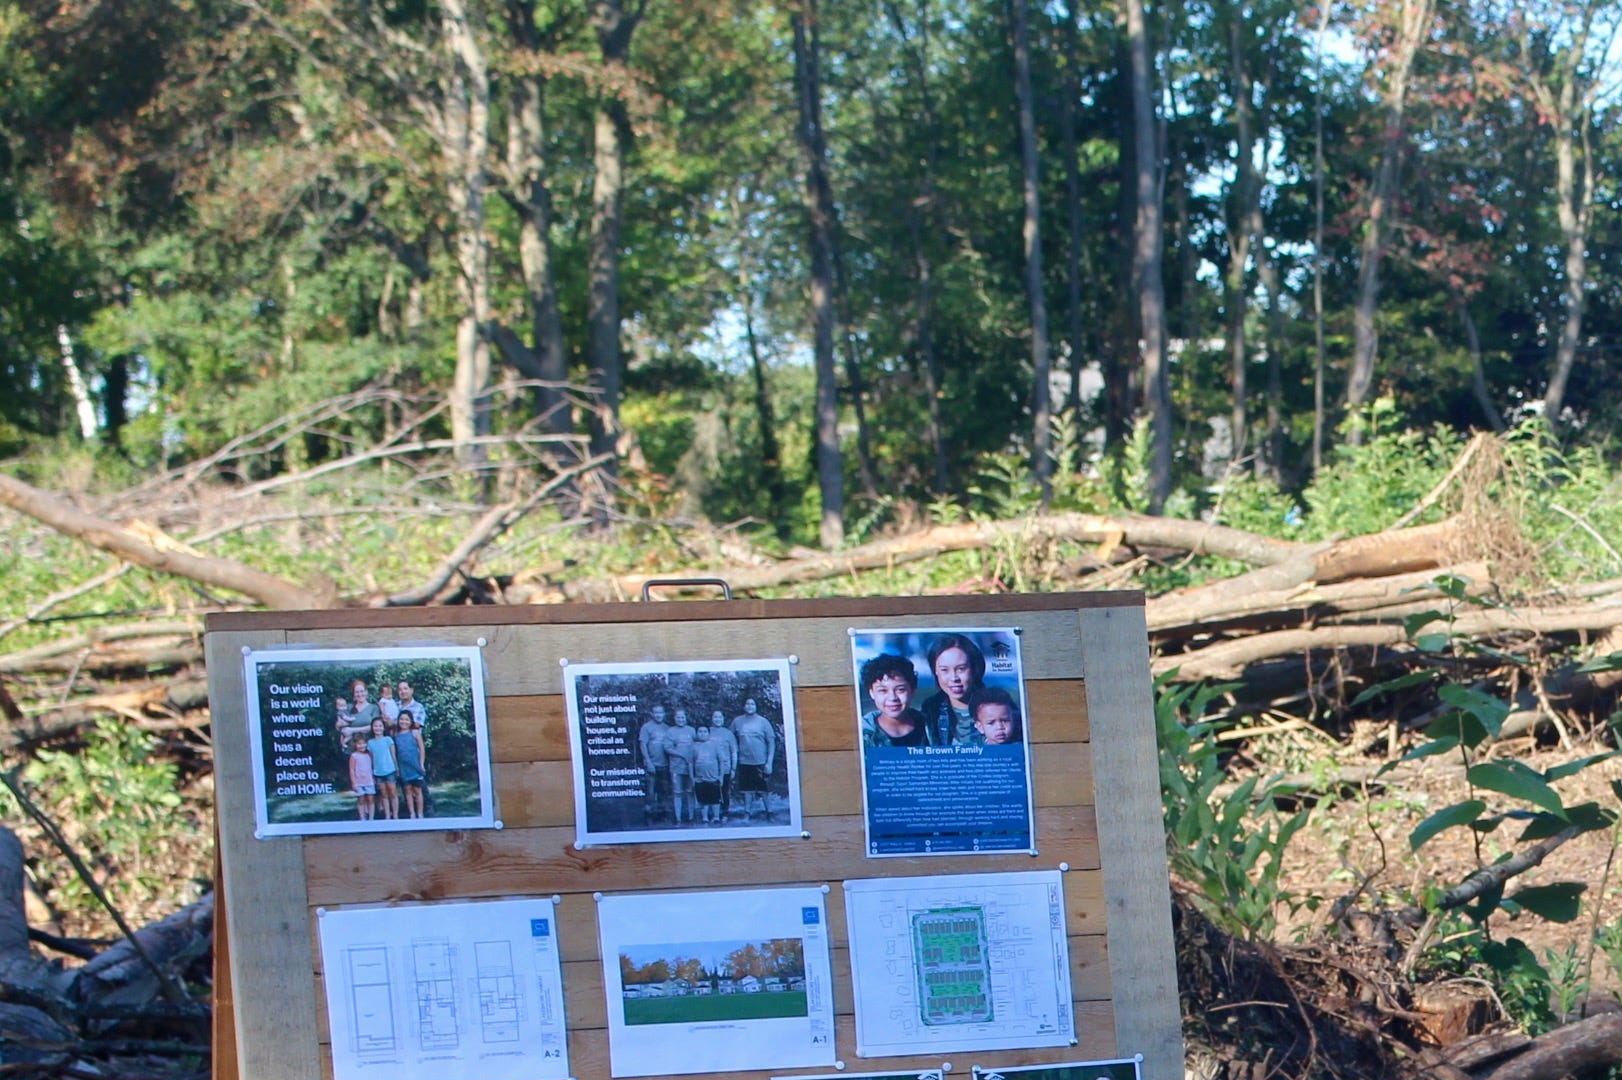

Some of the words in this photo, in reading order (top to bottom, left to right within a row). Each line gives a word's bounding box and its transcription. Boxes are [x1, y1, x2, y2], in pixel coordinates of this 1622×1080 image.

[270, 684, 289, 694] Our
[292, 685, 323, 694] vision
[271, 699, 280, 708] is
[290, 698, 320, 708] world
[584, 695, 597, 703] Our
[600, 695, 629, 703] mission
[630, 694, 636, 702] is
[598, 706, 612, 714] just
[272, 714, 305, 723] where
[273, 728, 322, 739] everyone
[588, 737, 613, 745] critical
[274, 742, 293, 752] has
[907, 747, 923, 755] The
[926, 747, 953, 755] Brown
[955, 746, 983, 755] Family
[275, 756, 312, 766] decent
[277, 771, 306, 782] place
[307, 771, 319, 780] to
[591, 779, 599, 787] to
[600, 779, 640, 787] transform
[277, 786, 296, 795] call
[298, 784, 335, 794] HOME.
[592, 790, 645, 798] communities.
[544, 1050, 560, 1058] A-2
